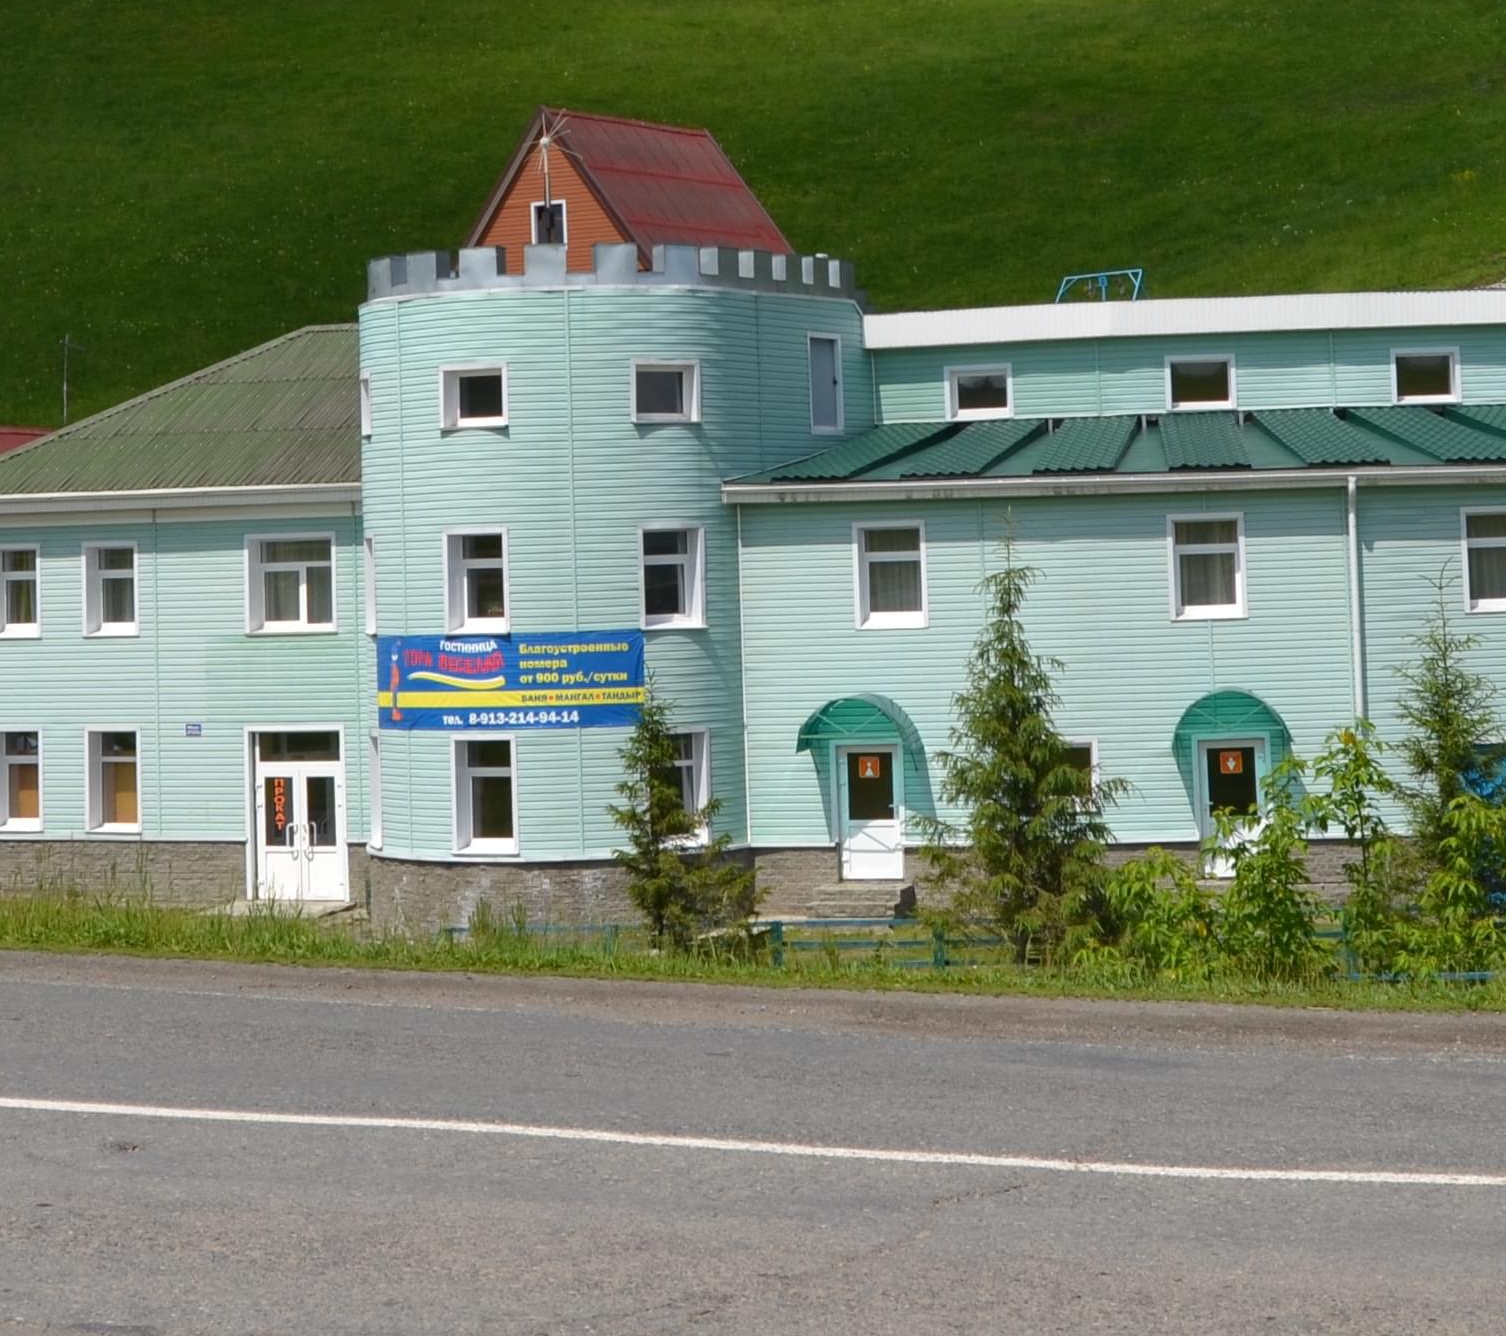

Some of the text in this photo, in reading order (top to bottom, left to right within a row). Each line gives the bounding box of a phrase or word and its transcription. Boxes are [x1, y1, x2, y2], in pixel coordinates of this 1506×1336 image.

[439, 640, 498, 653] ГОСТИНИЦА
[519, 659, 568, 669] номера
[519, 671, 628, 685] от 900 руб./сутки
[521, 692, 642, 702] БАНЯ МАНГАЛ ТАНДЫР
[443, 712, 579, 726] тел. 8-913-214-94-14
[275, 778, 285, 831] ПРОКАТ
